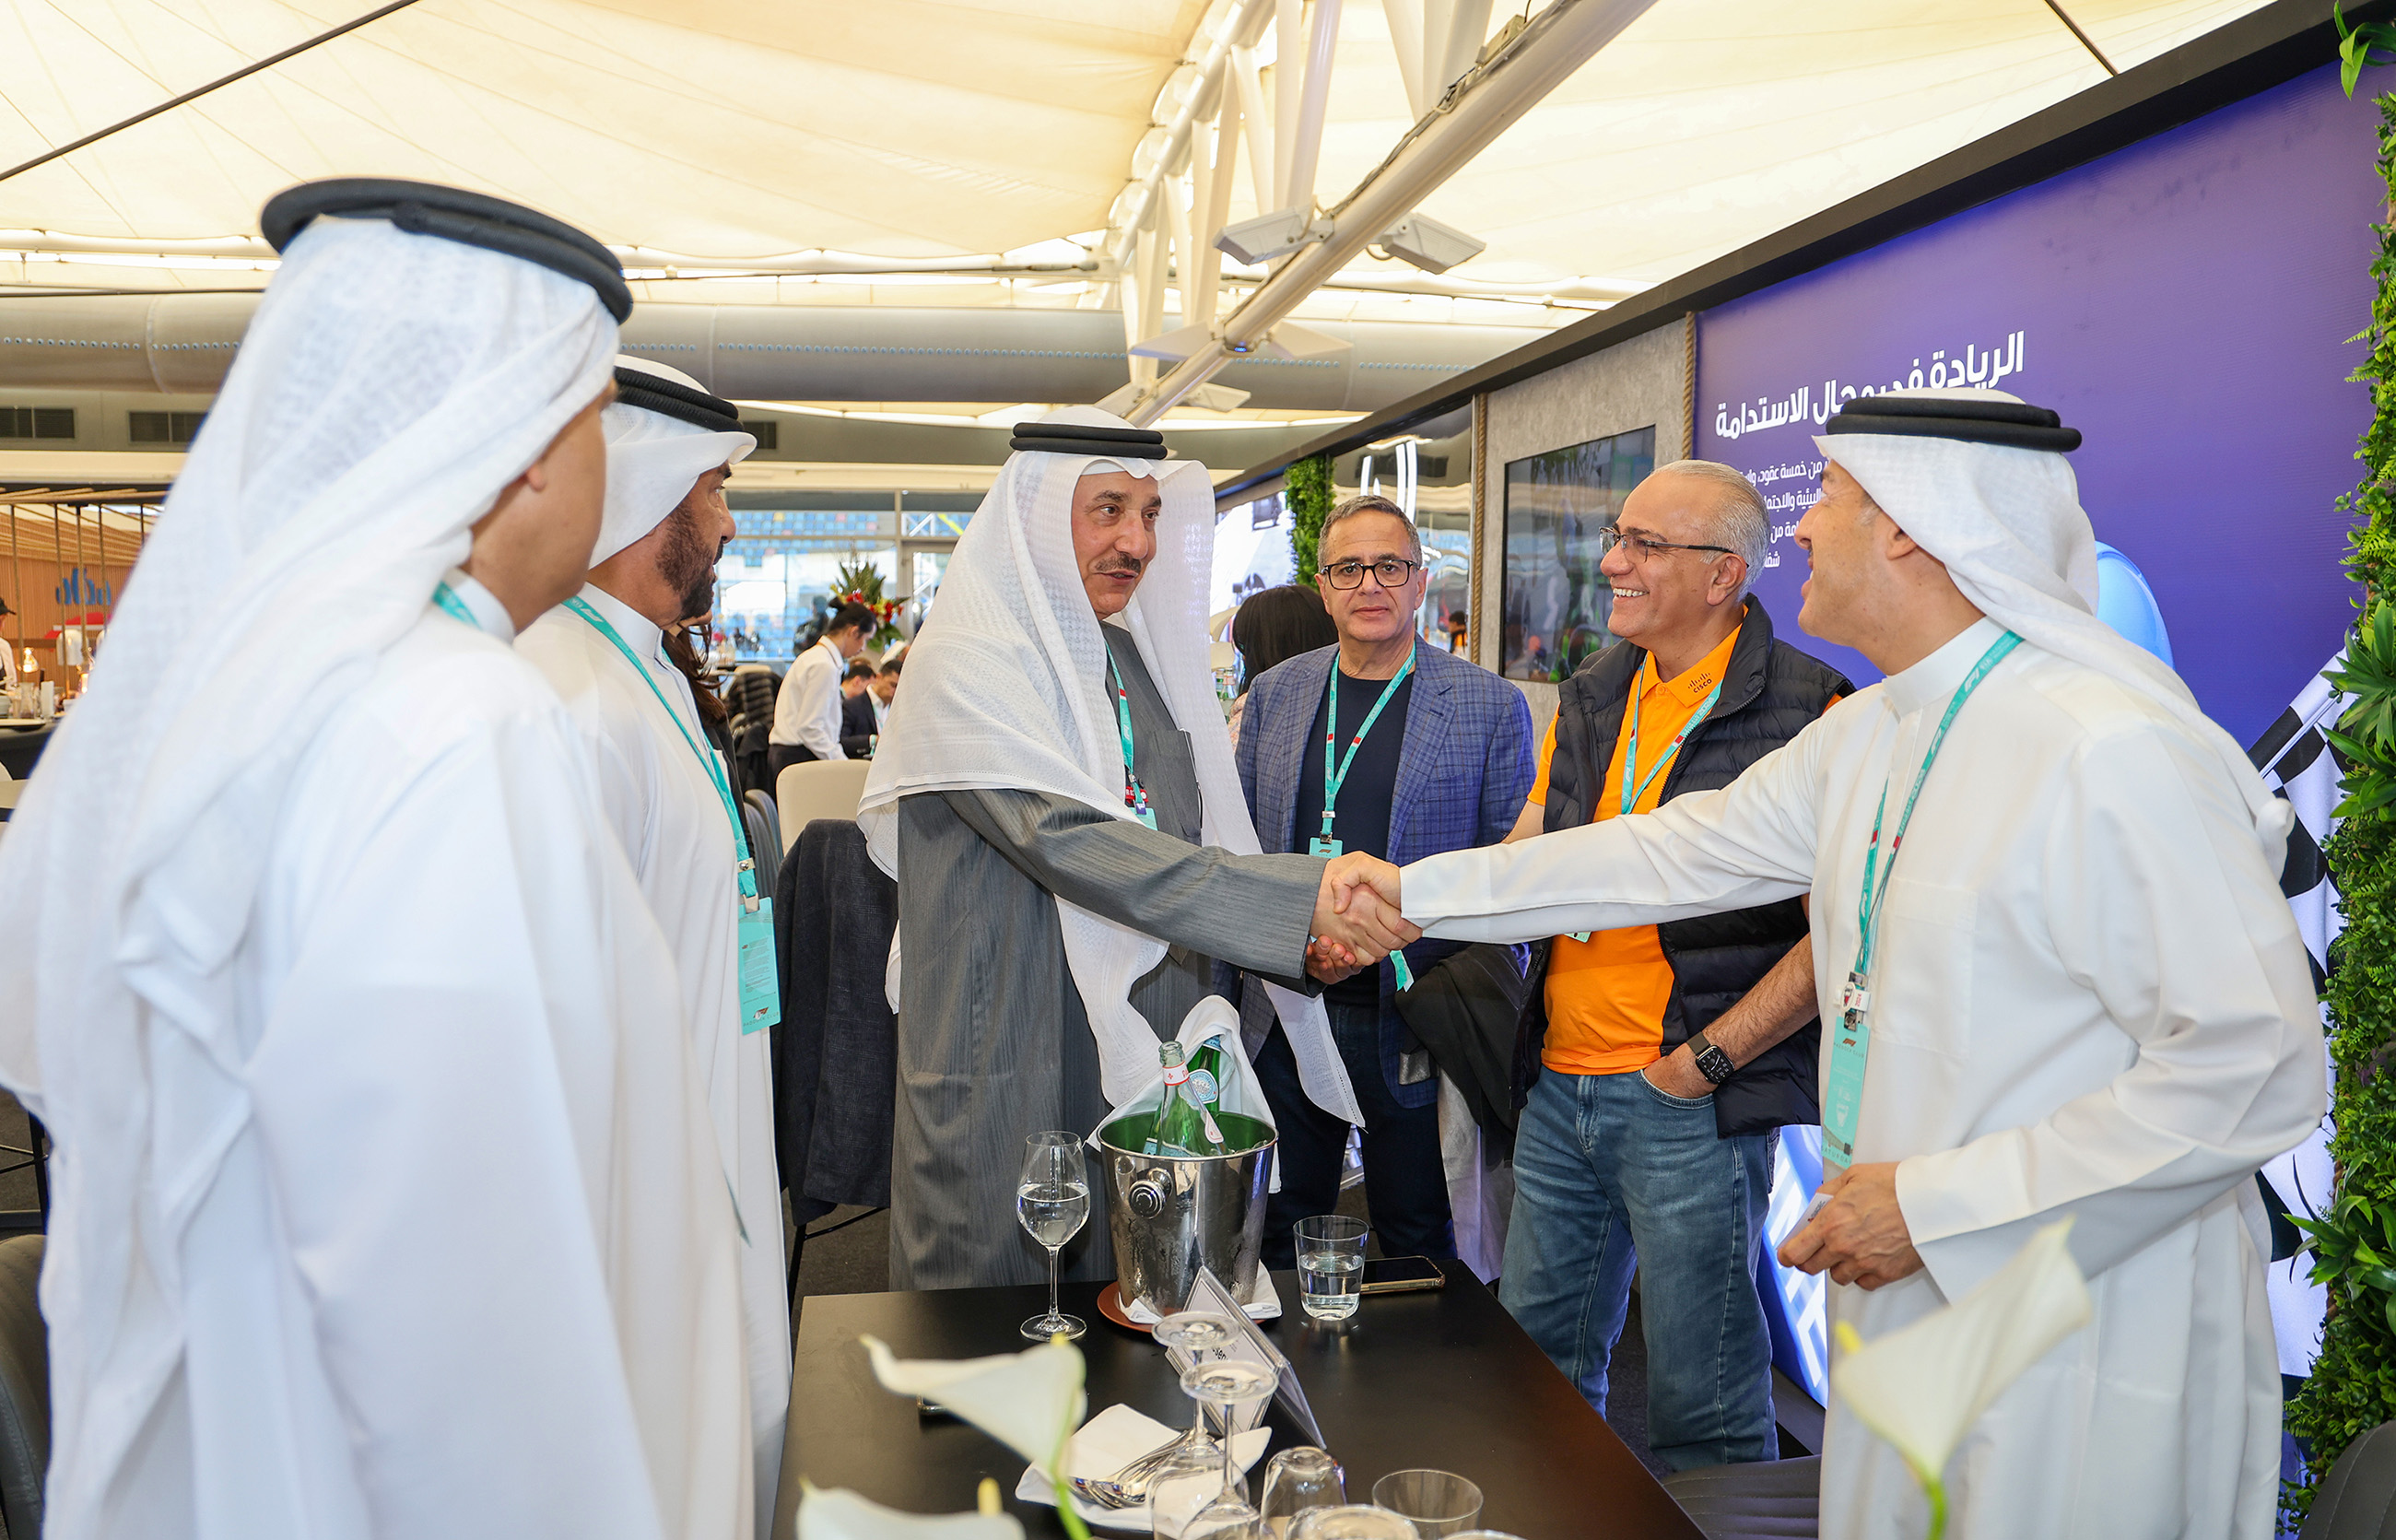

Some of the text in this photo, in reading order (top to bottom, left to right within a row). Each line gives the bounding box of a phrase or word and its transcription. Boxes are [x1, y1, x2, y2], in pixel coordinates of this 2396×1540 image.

[1930, 330, 2025, 391] الريادة
[1715, 386, 1810, 440] الاستدامة
[1779, 460, 1807, 479] خمسة
[1808, 460, 1823, 480] من
[1796, 488, 1822, 510] البيئية
[1769, 525, 1784, 544] من
